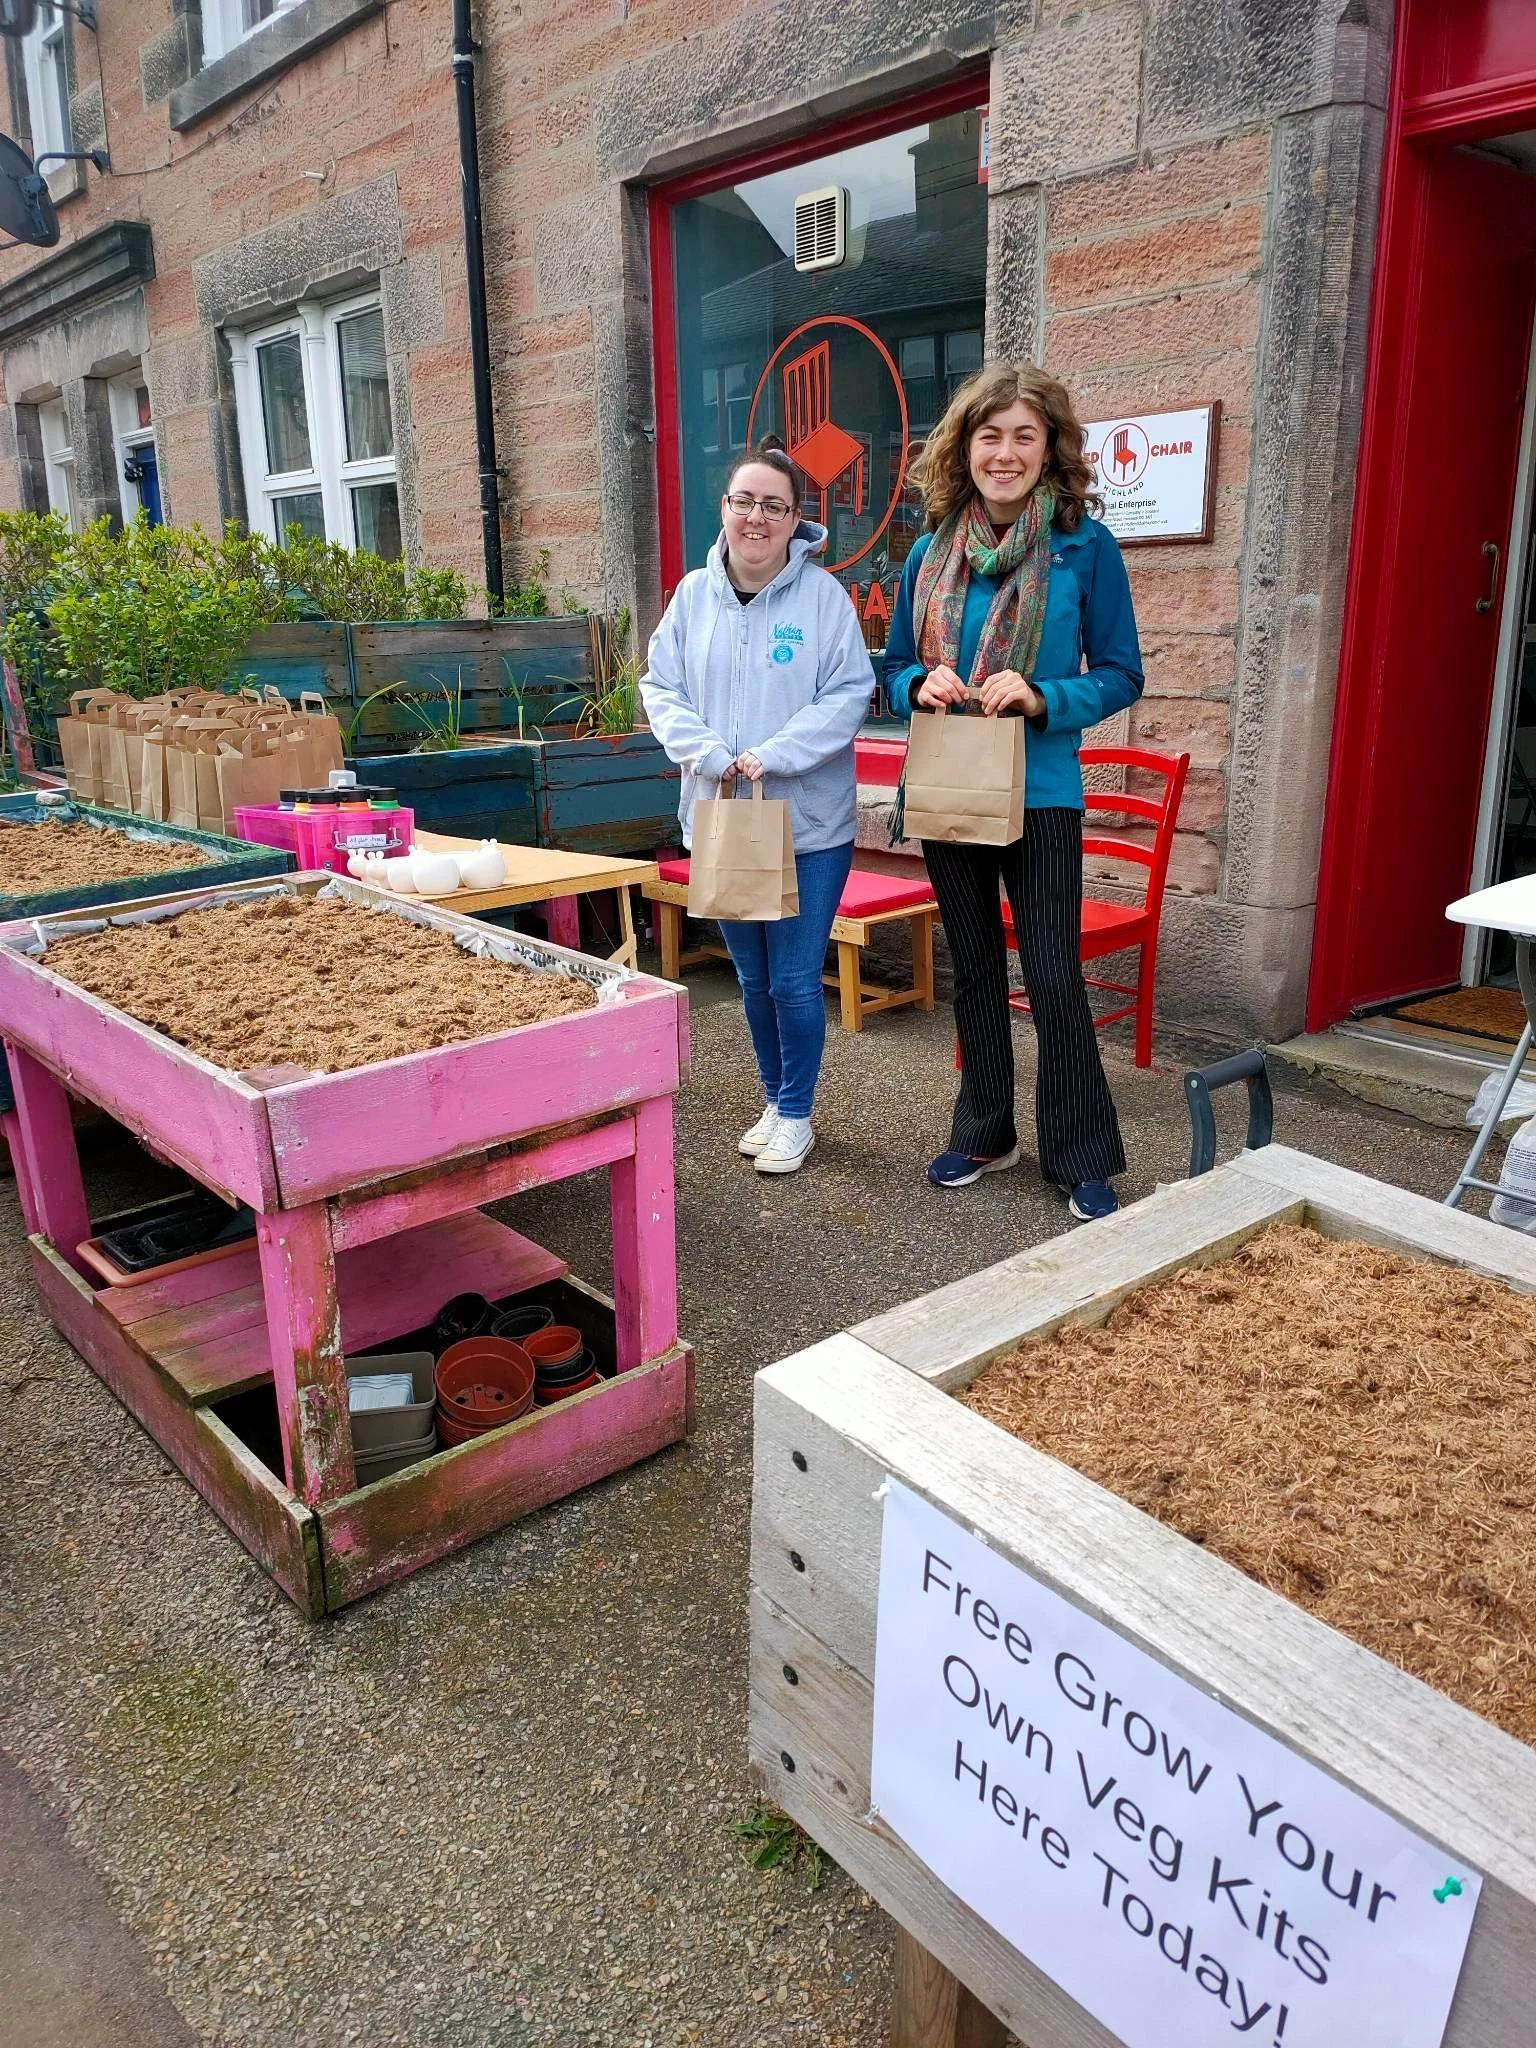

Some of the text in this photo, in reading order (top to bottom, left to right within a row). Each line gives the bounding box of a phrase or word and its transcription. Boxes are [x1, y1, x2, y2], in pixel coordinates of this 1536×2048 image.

[1083, 440, 1193, 464] ED CHAIR
[1103, 481, 1144, 497] HIGHLAND
[1118, 499, 1157, 509] Enterprise
[923, 1549, 1397, 1923] Free Grow Your
[943, 1655, 1330, 1985] Own Veg Kits
[954, 1739, 1289, 2048] Here Today!
